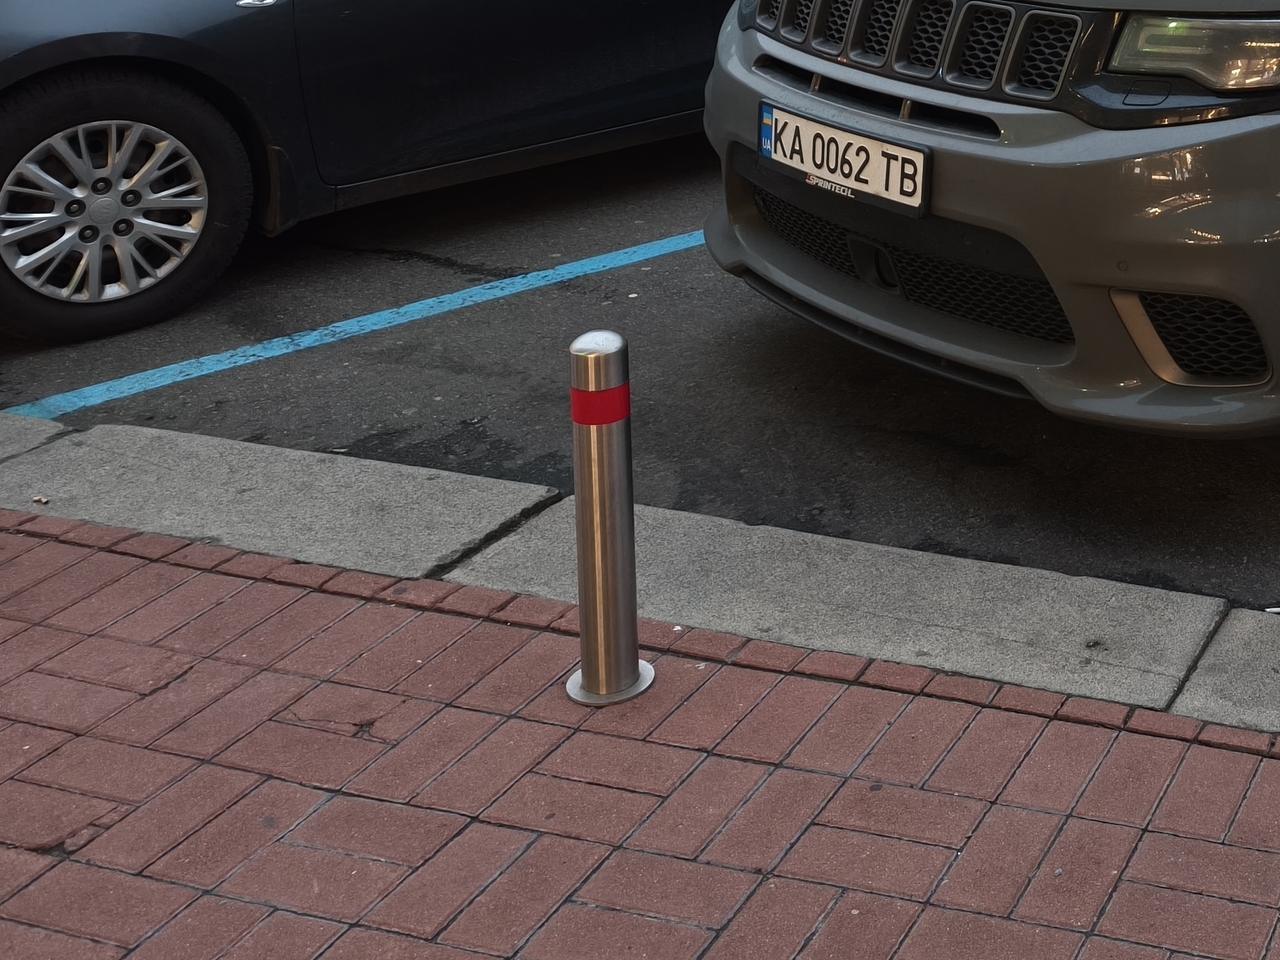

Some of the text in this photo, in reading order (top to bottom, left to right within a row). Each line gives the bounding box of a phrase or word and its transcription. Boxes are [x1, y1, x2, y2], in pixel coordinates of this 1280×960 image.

[762, 117, 918, 198] UA KA 0062 TB
